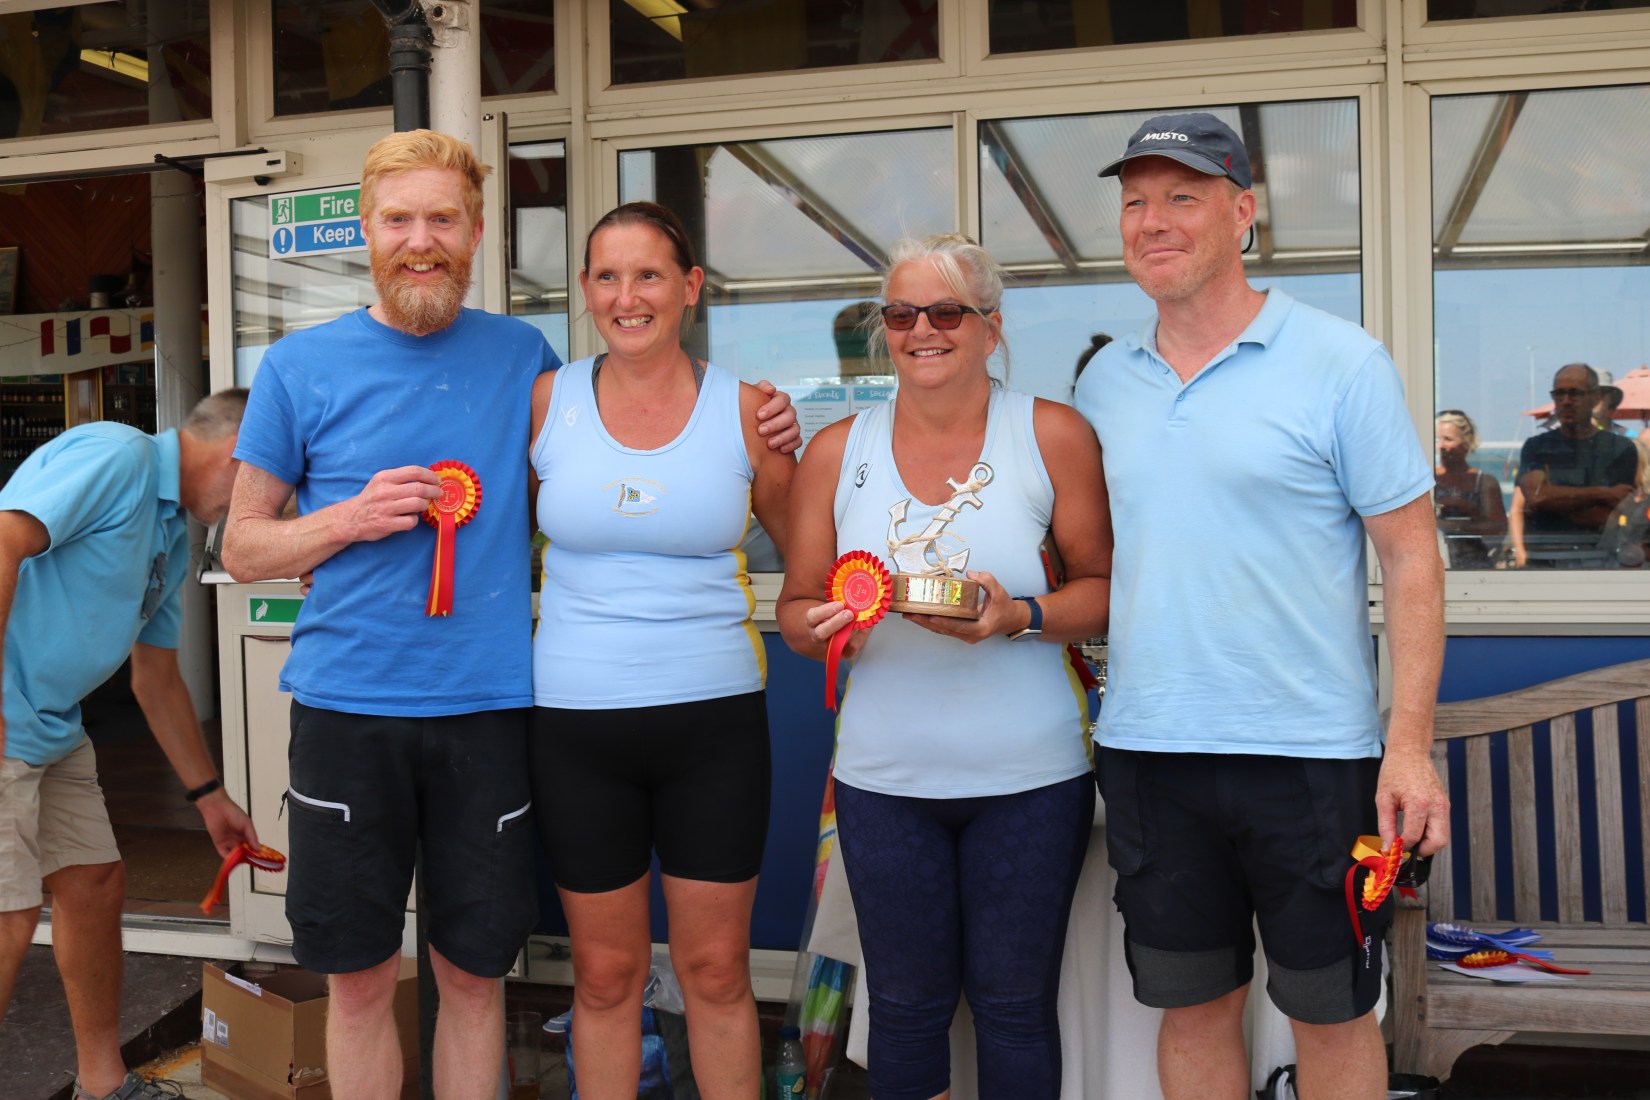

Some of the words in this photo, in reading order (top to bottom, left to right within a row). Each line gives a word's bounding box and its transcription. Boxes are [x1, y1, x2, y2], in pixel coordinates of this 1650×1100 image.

[1140, 132, 1188, 143] MUSTO
[319, 196, 355, 216] Fire
[313, 225, 356, 246] Keep
